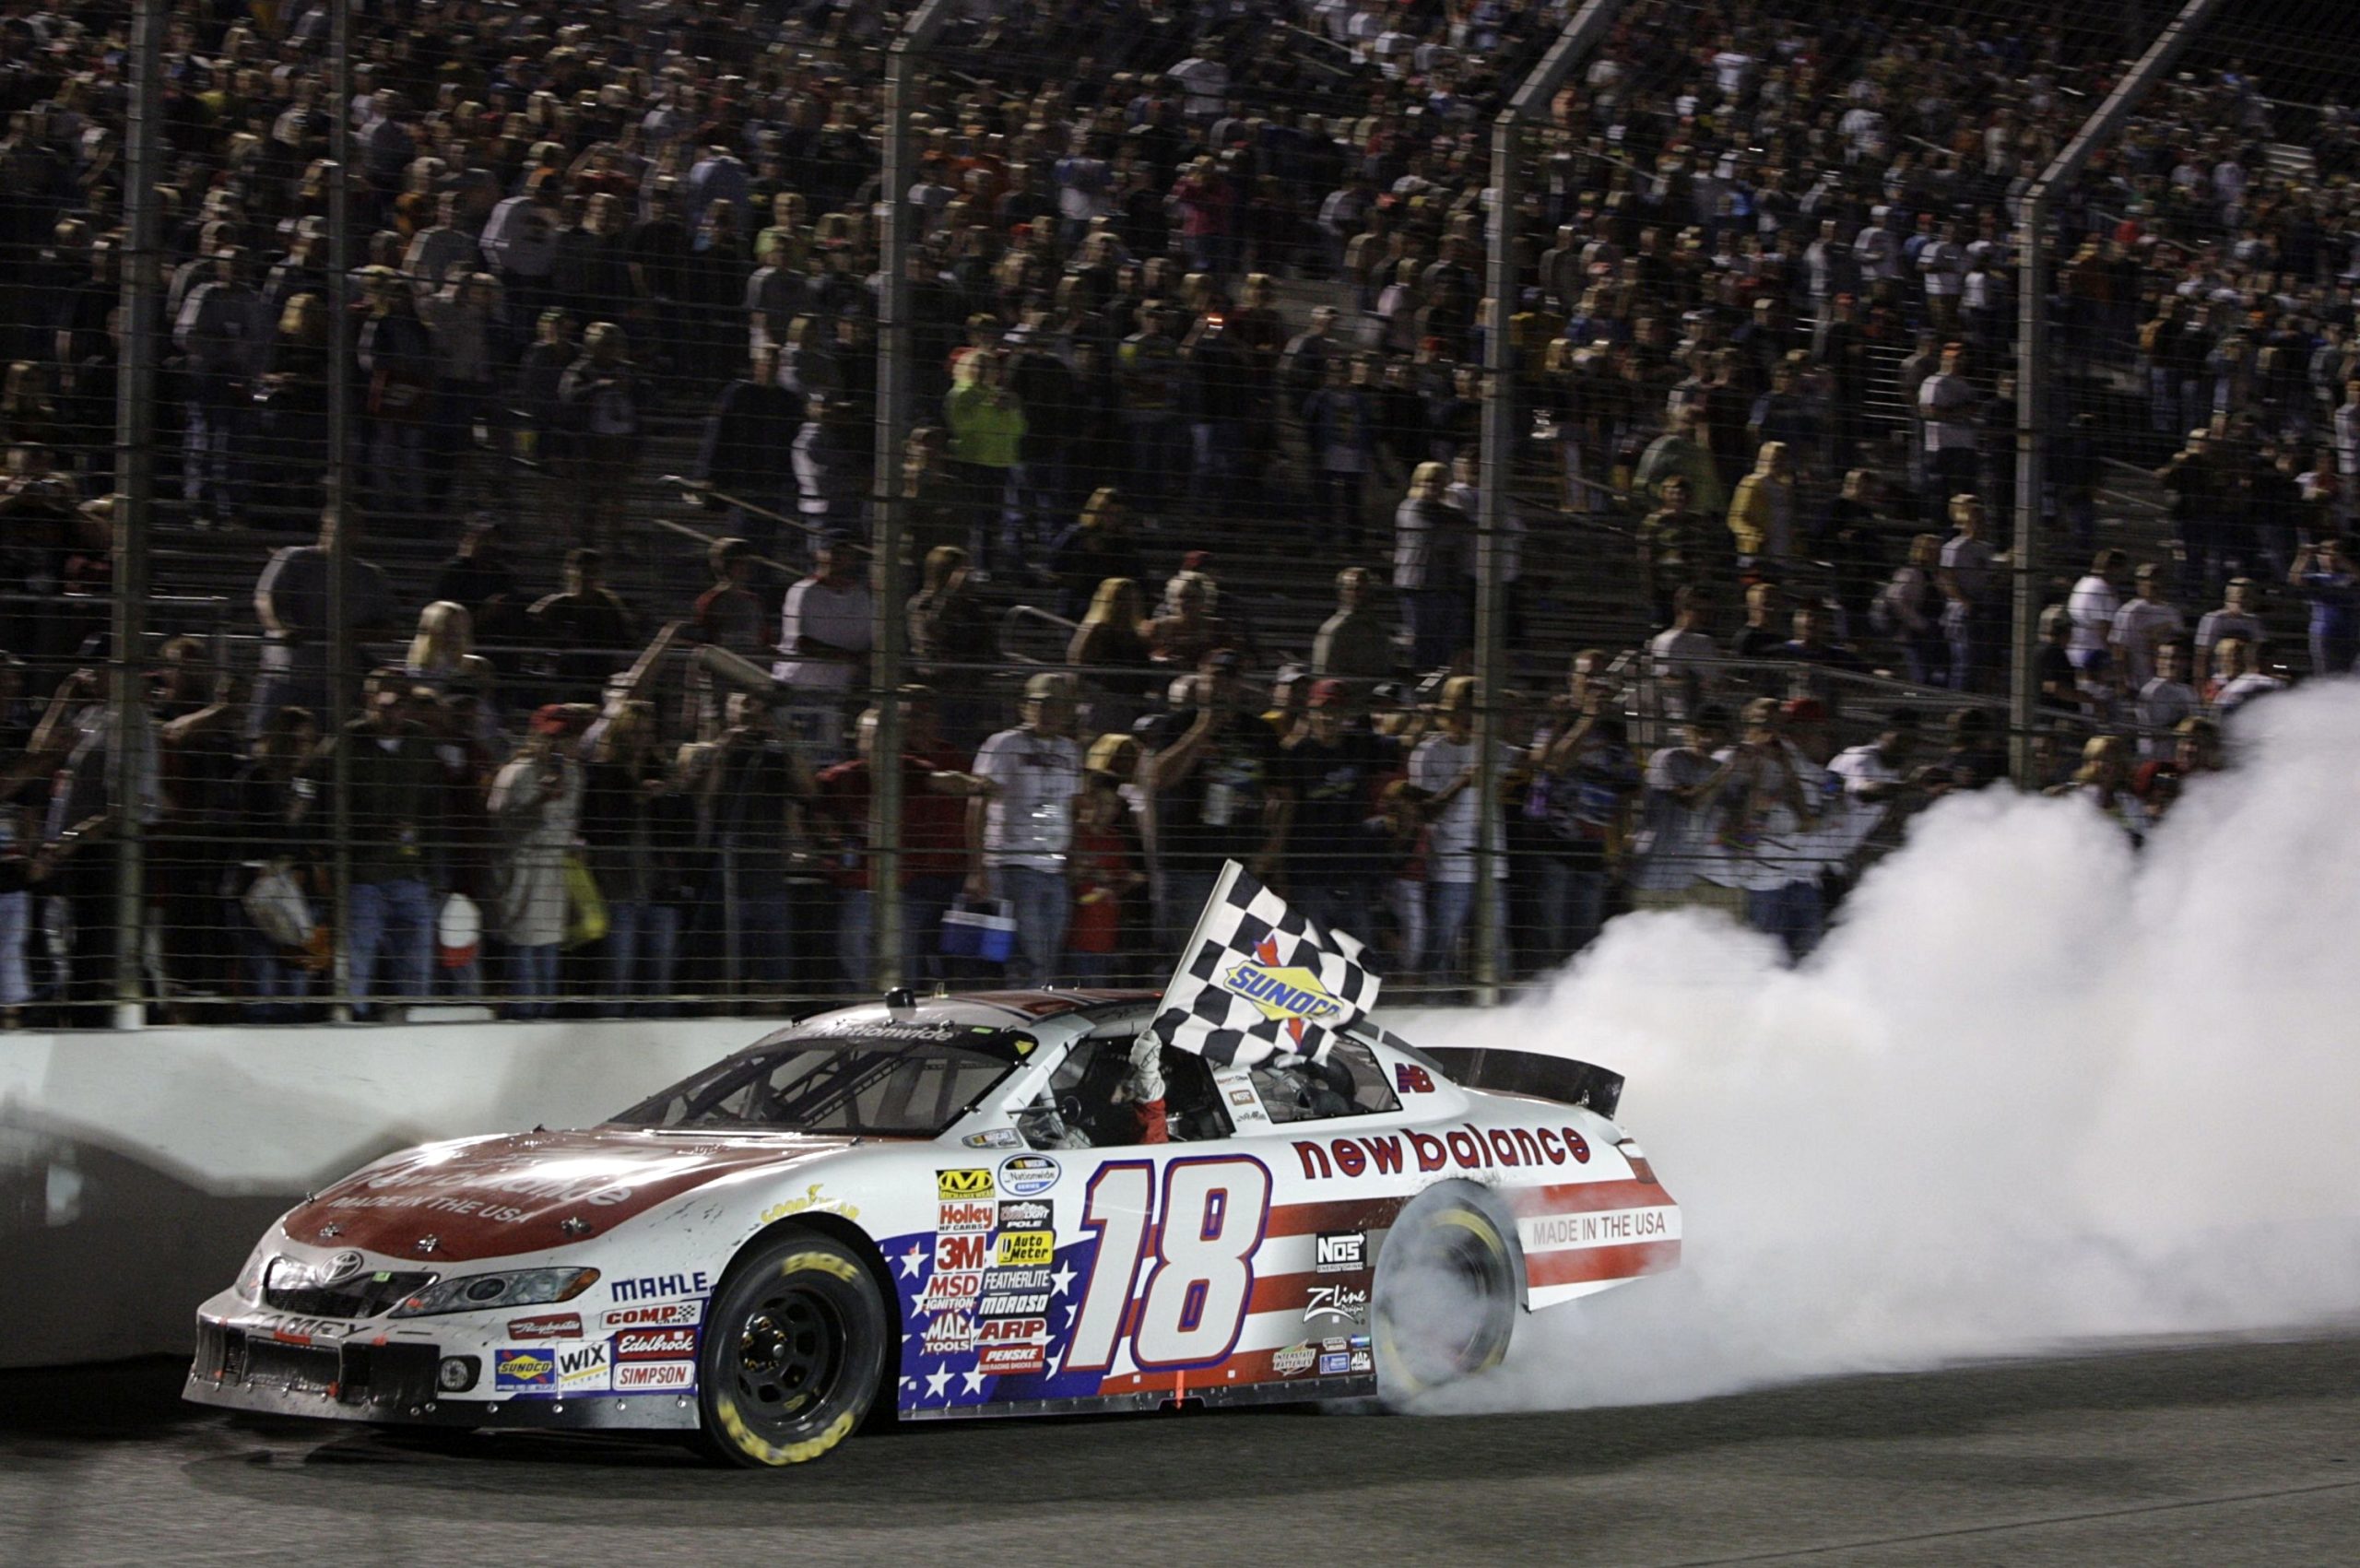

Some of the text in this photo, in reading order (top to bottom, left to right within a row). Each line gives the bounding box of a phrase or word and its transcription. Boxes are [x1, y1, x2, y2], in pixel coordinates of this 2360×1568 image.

[1009, 1171, 1056, 1181] Nationwide
[329, 1197, 388, 1208] MADE
[427, 1197, 483, 1215] THE
[478, 1206, 537, 1224] USA
[761, 1197, 860, 1224] GOODAR
[940, 1203, 993, 1230] Holley
[1533, 1211, 1667, 1244] MADE IN THE USA
[1014, 1236, 1043, 1247] Auto
[1317, 1232, 1364, 1263] NOS
[938, 1235, 985, 1270] 3M
[1011, 1248, 1048, 1259] Meter
[1062, 1153, 1273, 1373] 18
[611, 1272, 708, 1302] MAHLE
[928, 1275, 978, 1298] MSD
[984, 1269, 1050, 1290] FEATHERLITE
[926, 1297, 974, 1310] IGNITION
[978, 1293, 1048, 1315] MOROSO
[606, 1306, 677, 1325] COMP
[926, 1313, 971, 1340] MAC
[978, 1320, 1044, 1340] ARP
[619, 1334, 693, 1353] Edelbrock
[925, 1340, 970, 1352] TOOLS
[560, 1345, 607, 1373] WIX
[985, 1348, 1039, 1362] PENSKE
[501, 1362, 550, 1373] SUNOCO
[620, 1366, 686, 1385] SIMPSON
